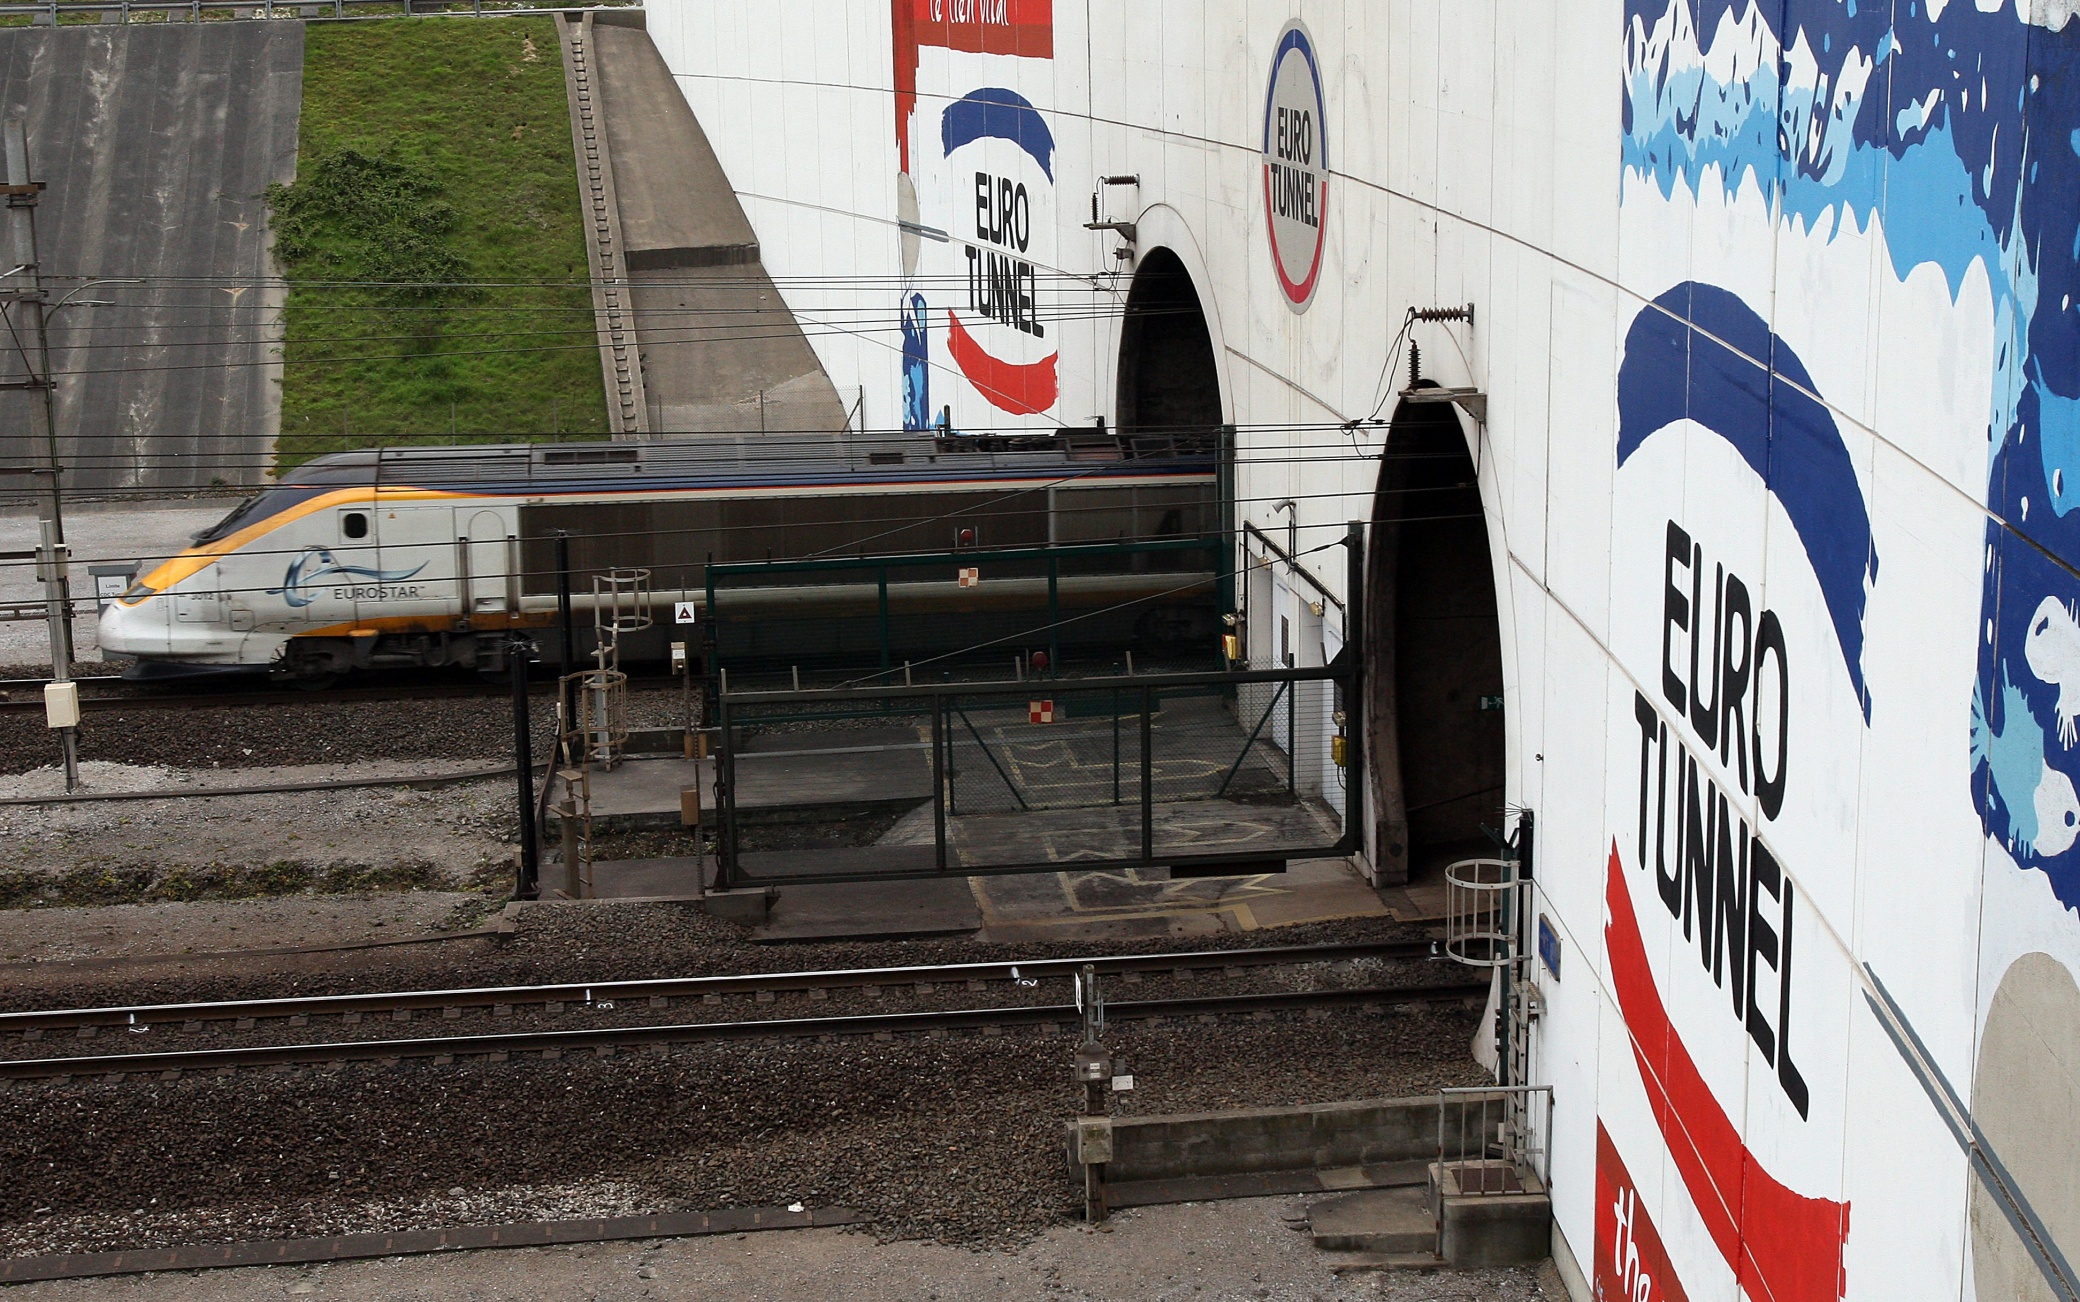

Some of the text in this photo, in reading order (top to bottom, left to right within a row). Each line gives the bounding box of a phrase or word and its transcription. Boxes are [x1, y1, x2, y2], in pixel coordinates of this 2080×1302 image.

[1278, 106, 1312, 165] EURO
[975, 171, 1029, 254] EURO
[1270, 162, 1318, 228] TUNNEL
[965, 244, 1044, 339] TUNNEL
[1662, 519, 1789, 822] EURO
[1634, 688, 1809, 1123] TUNNEL
